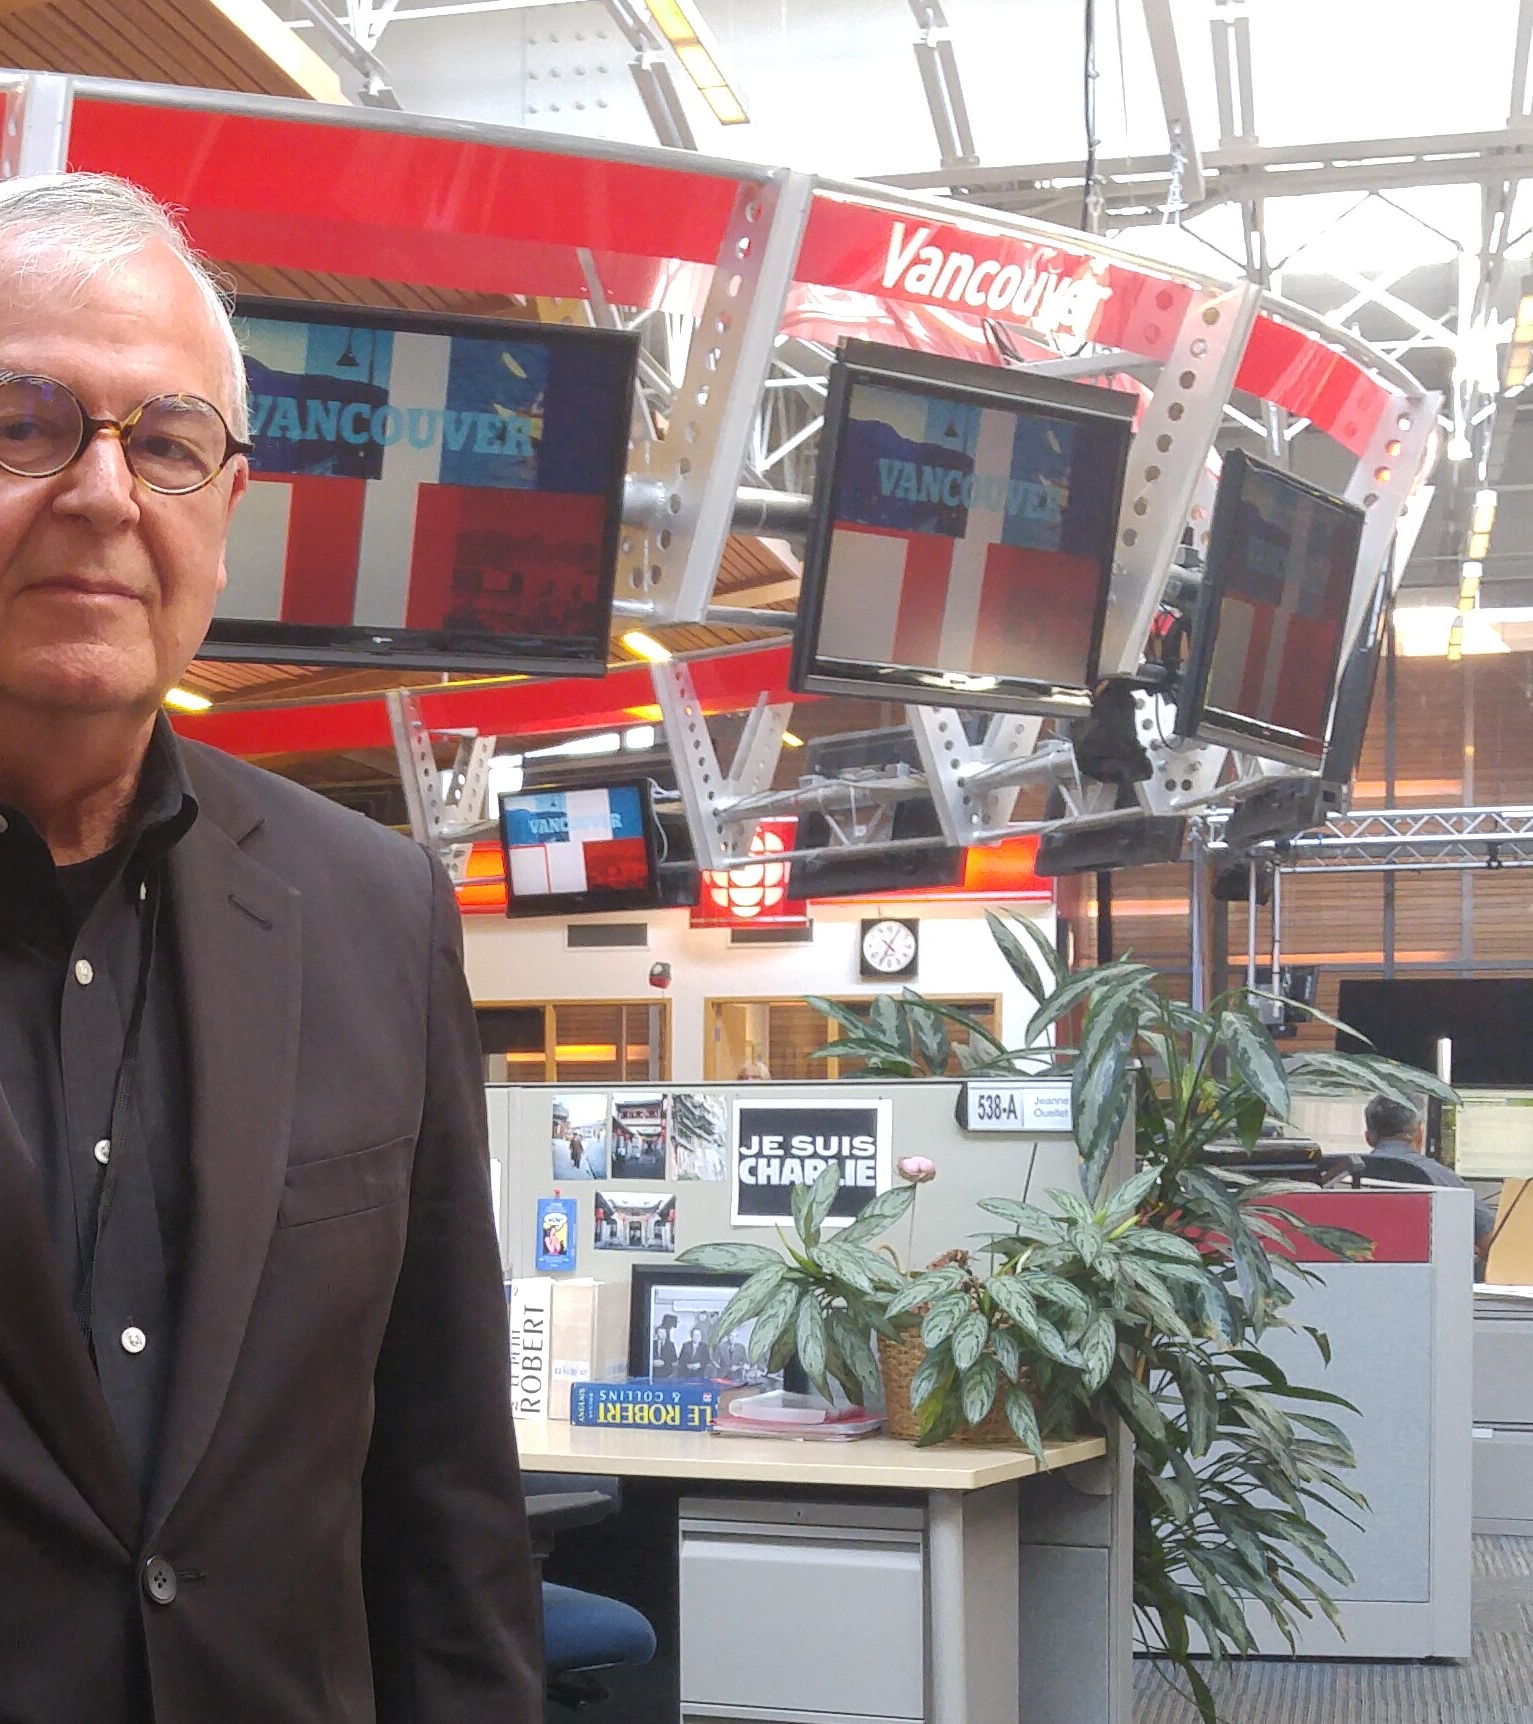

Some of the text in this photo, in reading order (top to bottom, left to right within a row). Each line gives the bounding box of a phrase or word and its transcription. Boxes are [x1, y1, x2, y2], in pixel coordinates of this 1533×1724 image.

[247, 395, 535, 456] VANCOUVER
[739, 1135, 876, 1156] JE SUIS
[520, 1304, 544, 1413] ROBERT
[599, 1389, 681, 1403] & COLLINS
[596, 1402, 681, 1426] ROBERT
[686, 1405, 712, 1426] LE
